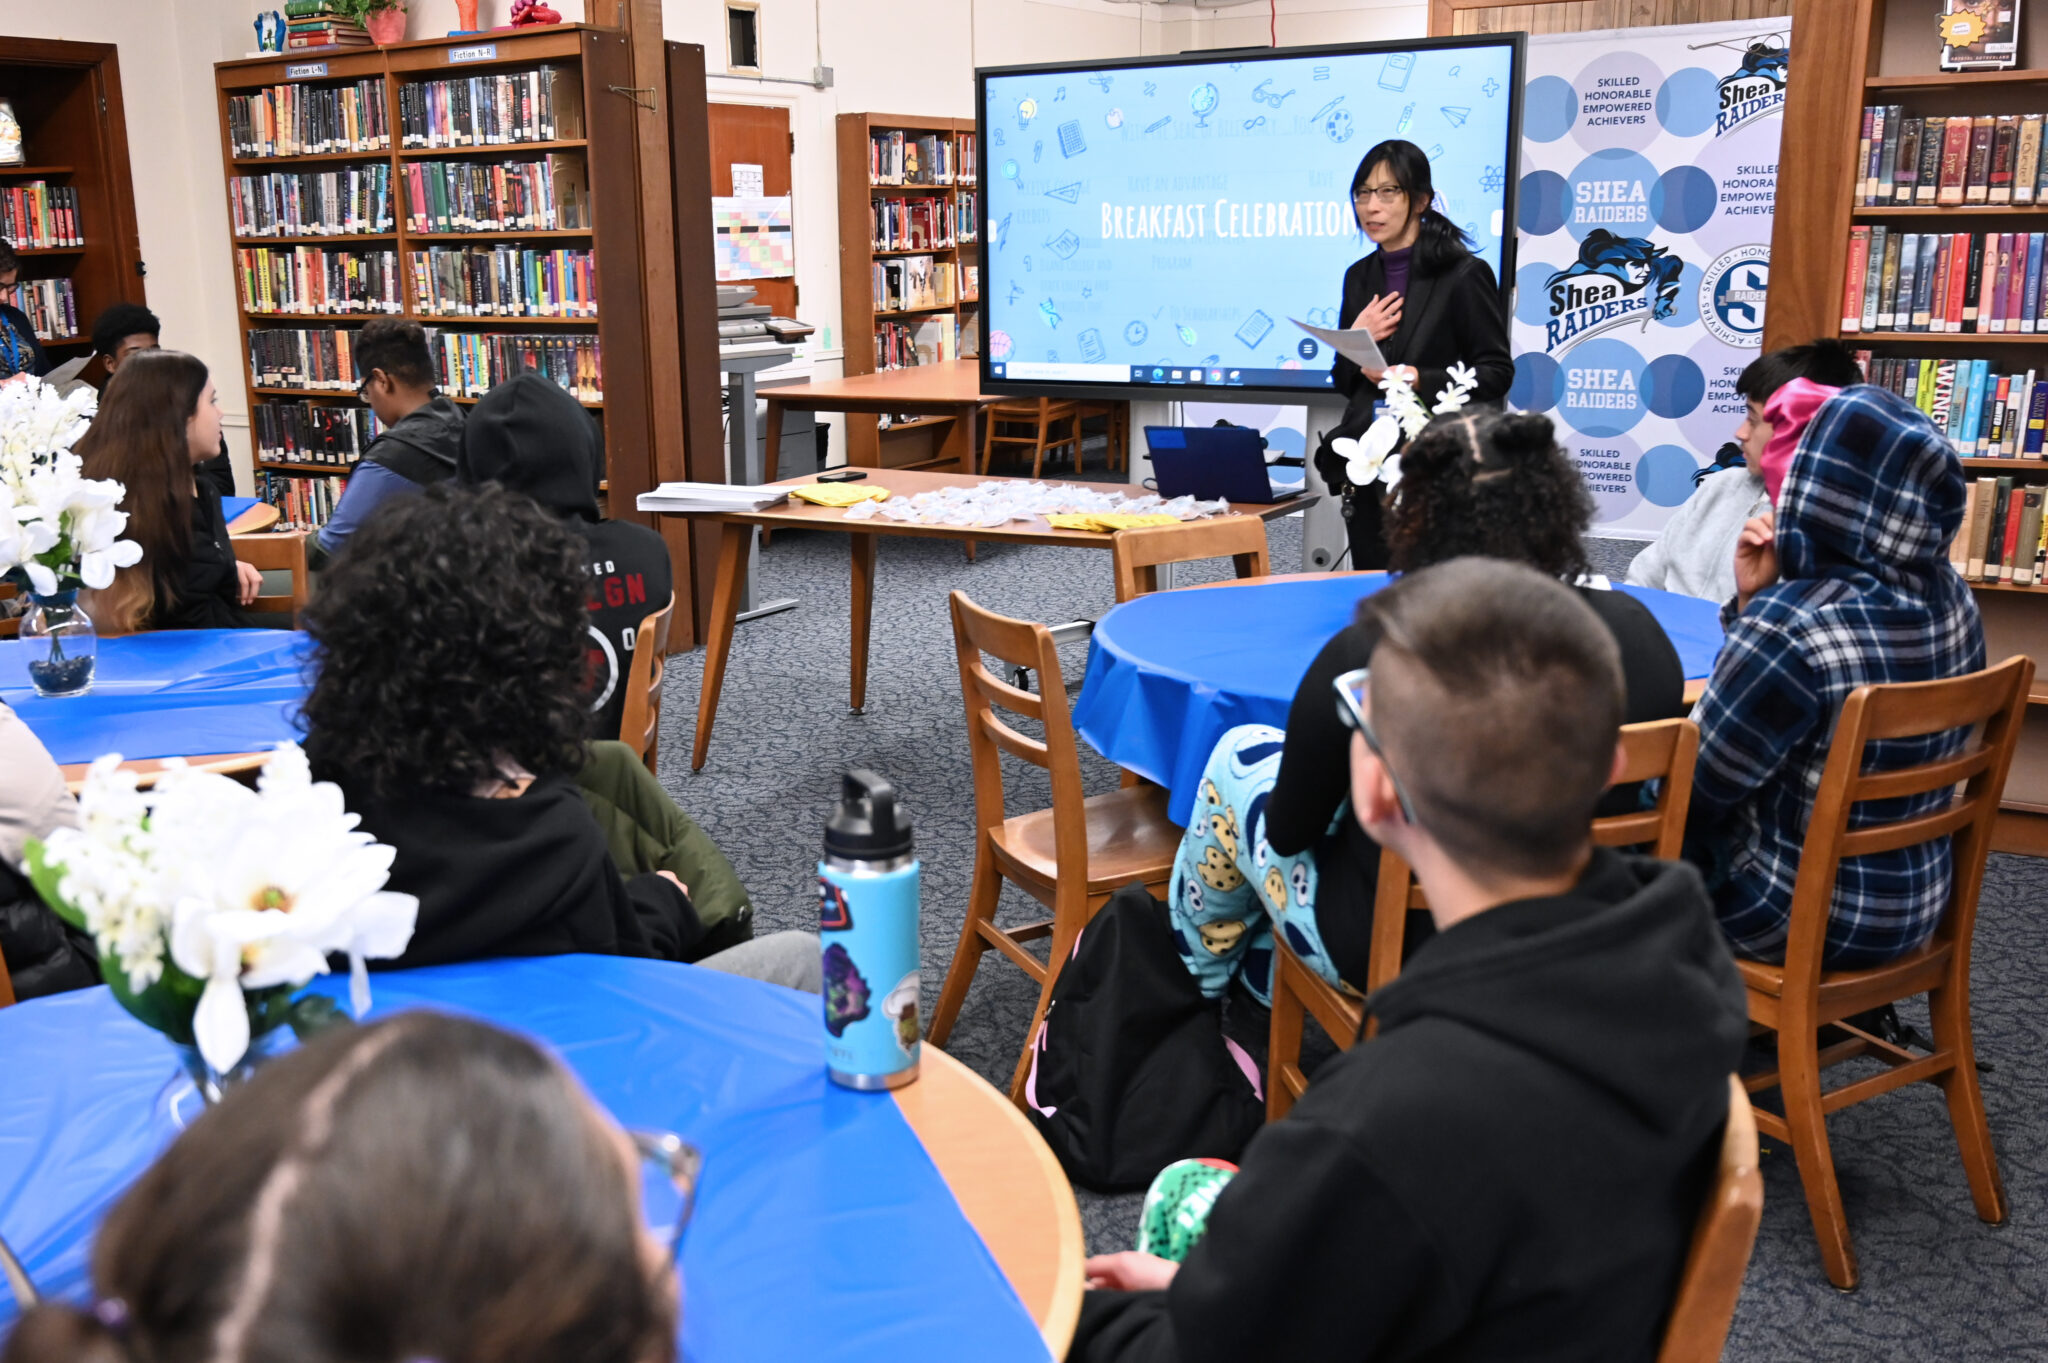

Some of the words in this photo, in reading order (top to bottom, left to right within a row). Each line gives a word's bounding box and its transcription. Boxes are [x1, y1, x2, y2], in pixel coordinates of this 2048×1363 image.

[453, 50, 475, 59] Fiction
[290, 66, 309, 75] Fiction
[1597, 77, 1640, 87] SKILLED
[1584, 89, 1652, 100] HONORABLE
[1719, 83, 1770, 110] Shea
[1583, 102, 1652, 113] EMPOWERED
[1587, 115, 1646, 126] ACHIEVERS
[1715, 93, 1785, 137] RAIDER
[1944, 152, 1959, 175] Fyre
[1723, 179, 1775, 188] HONORA
[1575, 180, 1647, 203] SHEA
[1720, 192, 1776, 202] EMPOWE
[1574, 205, 1648, 223] RAIDERS
[1725, 206, 1775, 215] ACHIEVE
[1100, 201, 1207, 240] BREAKFAST
[1702, 256, 1732, 292] SKILLED
[1549, 283, 1617, 317] Shea
[1734, 291, 1767, 301] RAIDER
[1865, 300, 1874, 317] YOU
[1545, 297, 1648, 354] RAIDERS
[1702, 302, 1745, 345] ACHIEVERS
[1567, 368, 1636, 391] SHEA
[1566, 391, 1638, 410] RAIDERS
[1931, 363, 1957, 434] WING
[1712, 404, 1746, 414] ACHIE
[1580, 449, 1620, 458] SKILLED
[1574, 460, 1631, 471] ONORABLE
[1582, 471, 1632, 482] POWERED
[1586, 484, 1627, 494] HIEVERS
